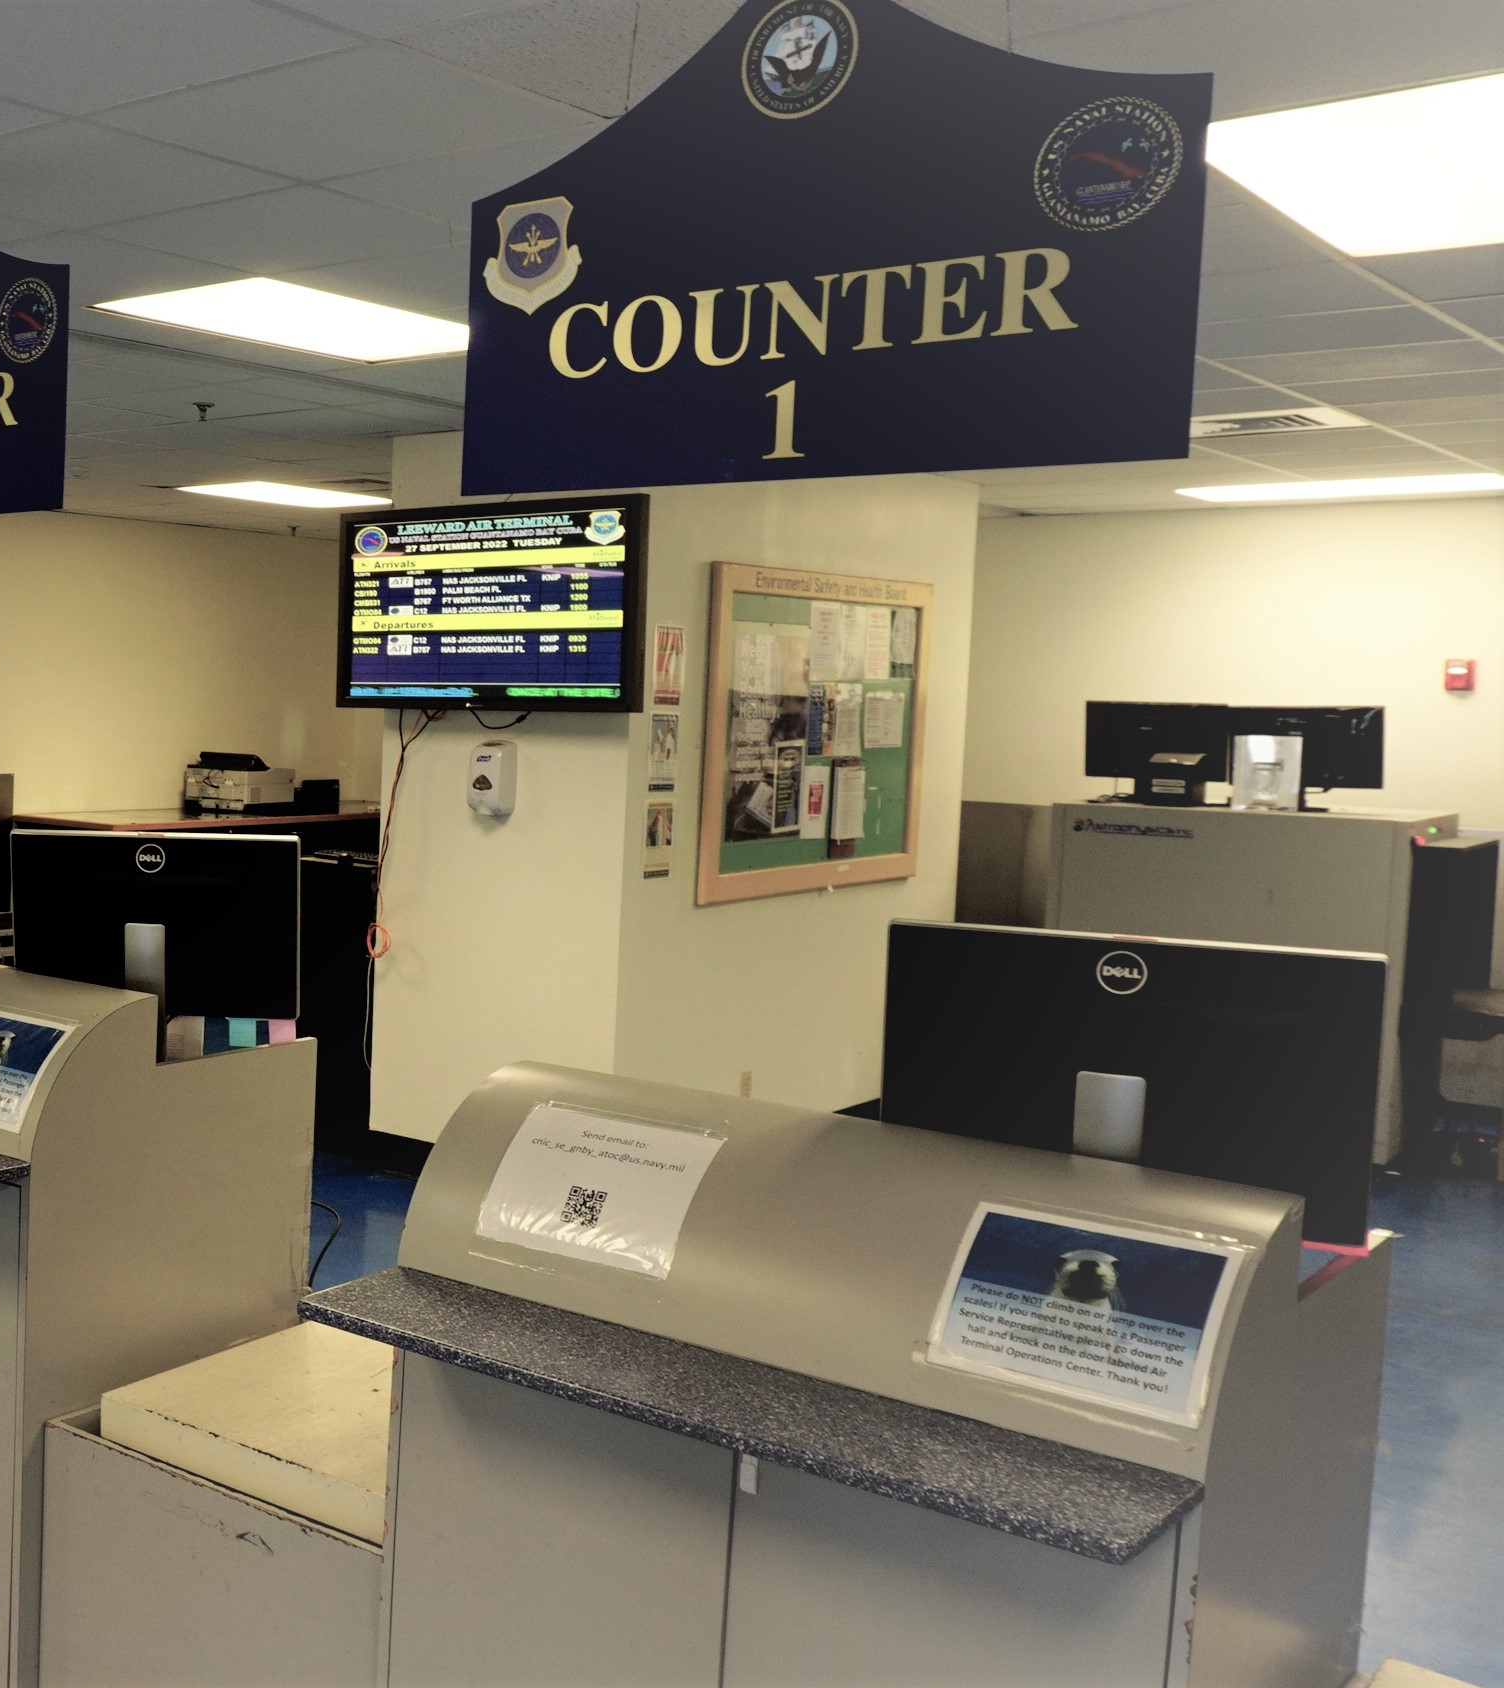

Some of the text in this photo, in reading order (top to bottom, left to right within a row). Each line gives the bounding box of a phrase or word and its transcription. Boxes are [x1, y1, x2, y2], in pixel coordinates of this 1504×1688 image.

[548, 247, 1079, 379] COUNTER
[761, 380, 806, 460] 1
[397, 515, 573, 536] LEEWARD AIR TERMINAL
[401, 534, 431, 544] NAVAL
[431, 532, 469, 542] STATION
[535, 528, 556, 536] BAY
[556, 526, 583, 535] CUBA
[405, 537, 563, 553] 27 SEPTEMBER 2022 TUESDAY
[373, 559, 417, 570] Arrivals
[442, 577, 458, 585] NAS
[458, 575, 516, 584] JACKSONVILLE
[516, 574, 528, 582] FL
[541, 573, 561, 581] KNIP
[755, 571, 908, 600] Environmental Safety and Health Board
[442, 586, 463, 594] PALM
[464, 585, 491, 594] BEACH
[491, 585, 502, 593] FL
[442, 596, 452, 604] FT
[452, 596, 481, 604] WORTH
[481, 594, 519, 603] ALLIANCE
[520, 594, 532, 602] TX
[414, 607, 428, 615] C12
[441, 606, 457, 614] NAS
[458, 604, 515, 613] JACKSONVILLE
[515, 604, 527, 612] FL
[540, 603, 561, 611] KNIP
[373, 621, 434, 631] Departures
[413, 636, 428, 644] C12
[440, 635, 456, 643] NAS
[457, 635, 514, 643] JACKSONVILLE
[514, 634, 526, 643] FL
[539, 634, 560, 643] KNIP
[456, 645, 514, 653] JACKSONVILLE
[514, 645, 526, 653] FL
[539, 645, 560, 653] KNIP
[568, 644, 587, 653] 1315
[139, 853, 162, 863] DELL
[1102, 965, 1142, 979] DELL
[581, 1129, 650, 1151] Send email to:
[971, 1283, 1186, 1339] Please do NOT climb on or jump over the
[963, 1295, 1187, 1353] scales! If you need to speak to a Passenger
[958, 1307, 1184, 1368] Service Representative please go down the
[967, 1322, 1168, 1378] hall and knock on the door labeled Air
[960, 1335, 1169, 1394] Terminal Operations Center. Thank you!
